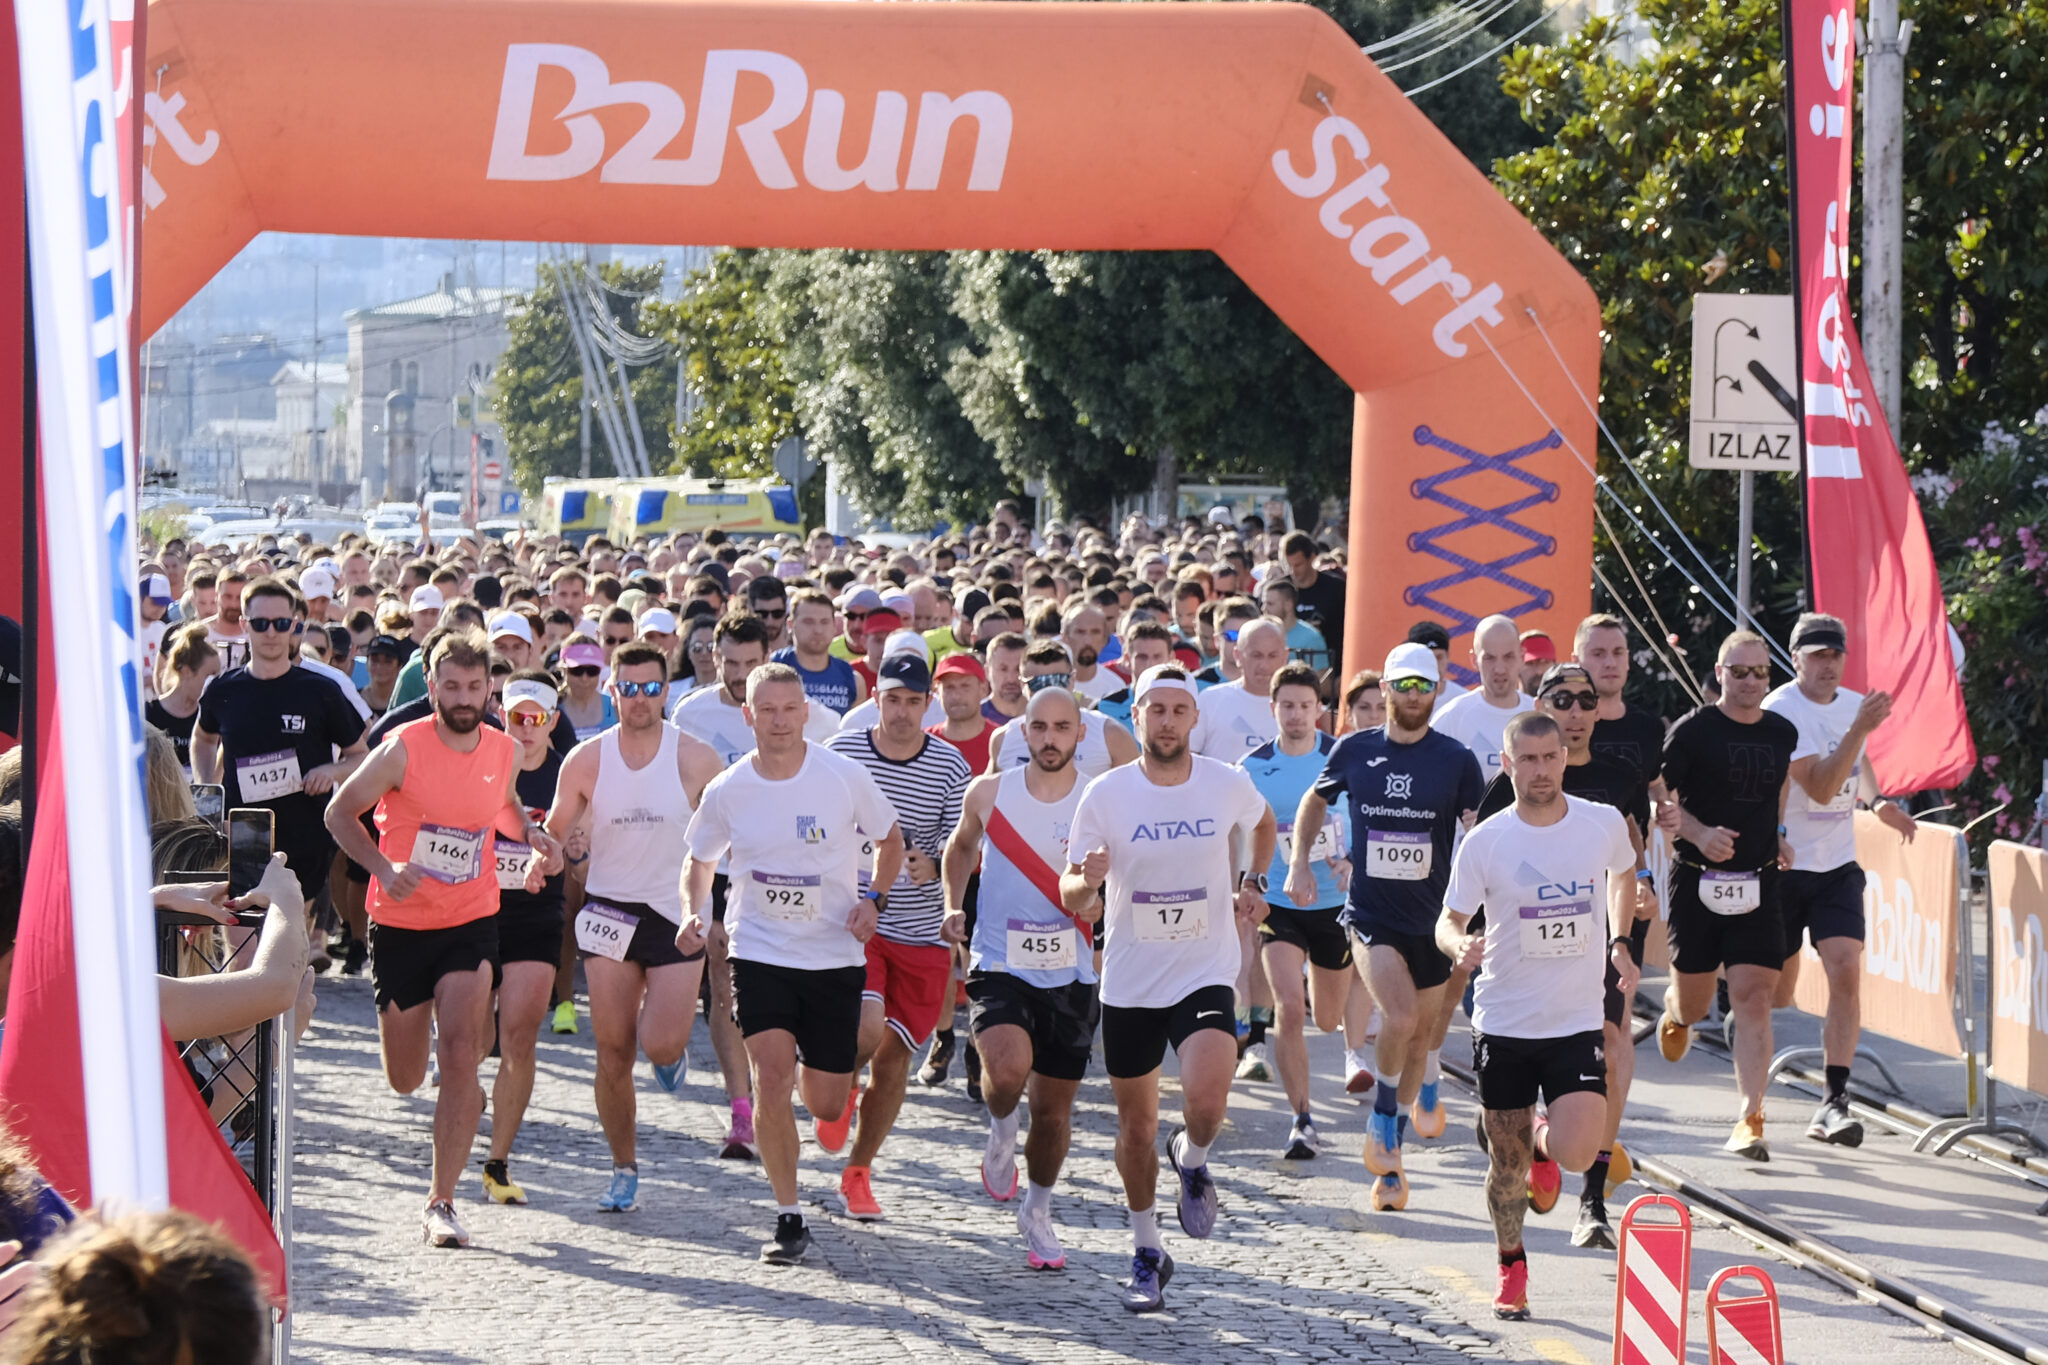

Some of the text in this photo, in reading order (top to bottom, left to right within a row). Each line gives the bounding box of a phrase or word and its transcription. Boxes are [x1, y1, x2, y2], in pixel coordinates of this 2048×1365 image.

[486, 43, 1013, 192] B2Run
[1272, 116, 1504, 357] Start
[1709, 433, 1791, 460] IZLAZ
[250, 768, 287, 786] 1437
[1361, 803, 1436, 820] OptimoRoute
[429, 841, 469, 861] 1466
[1376, 847, 1424, 864] 1090
[766, 889, 805, 906] 992
[1713, 885, 1744, 900] 541
[1157, 908, 1184, 925] 17
[584, 920, 620, 941] 1496
[1538, 921, 1576, 940] 121
[1022, 937, 1061, 952] 455
